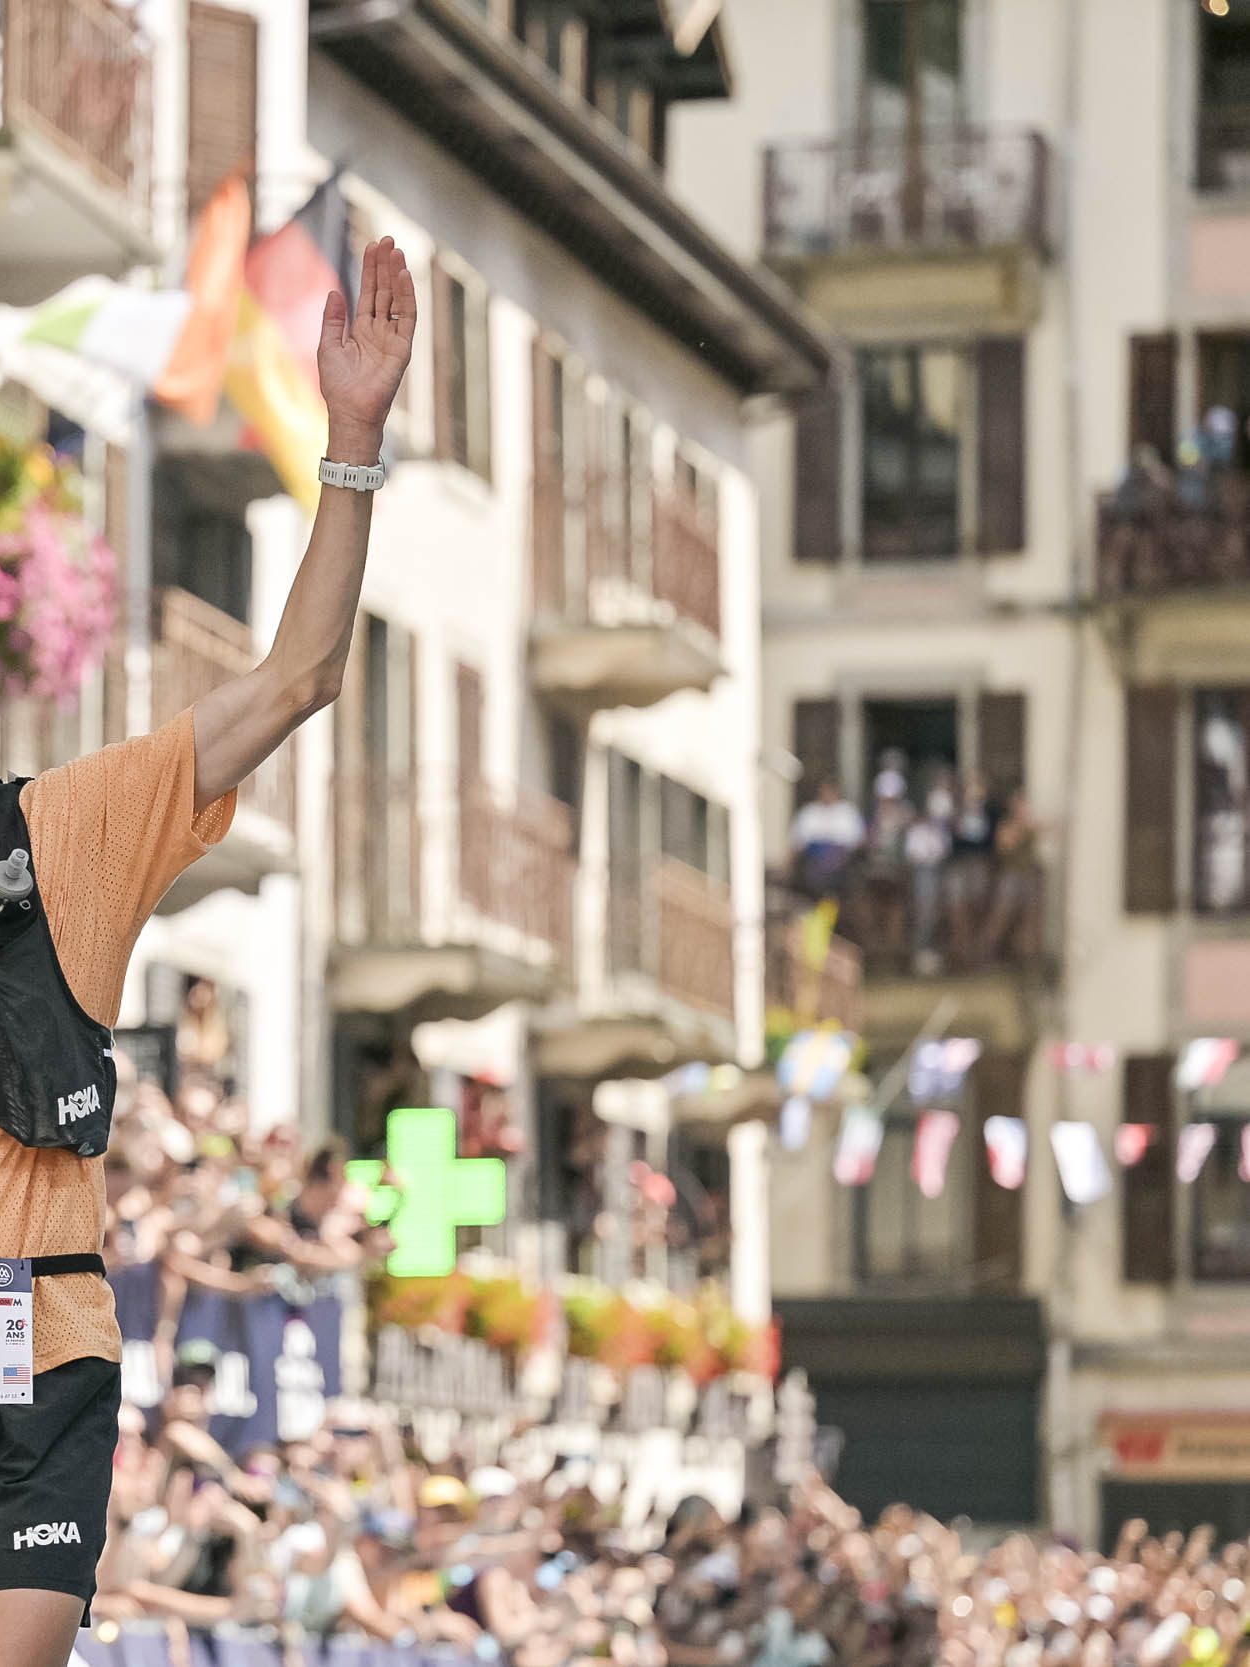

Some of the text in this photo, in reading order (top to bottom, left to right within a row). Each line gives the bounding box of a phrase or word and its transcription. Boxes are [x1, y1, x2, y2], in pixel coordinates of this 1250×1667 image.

[57, 1084, 101, 1125] HOKA
[5, 1319, 25, 1331] 20
[5, 1331, 25, 1339] ANS
[13, 1521, 82, 1551] HOKA
